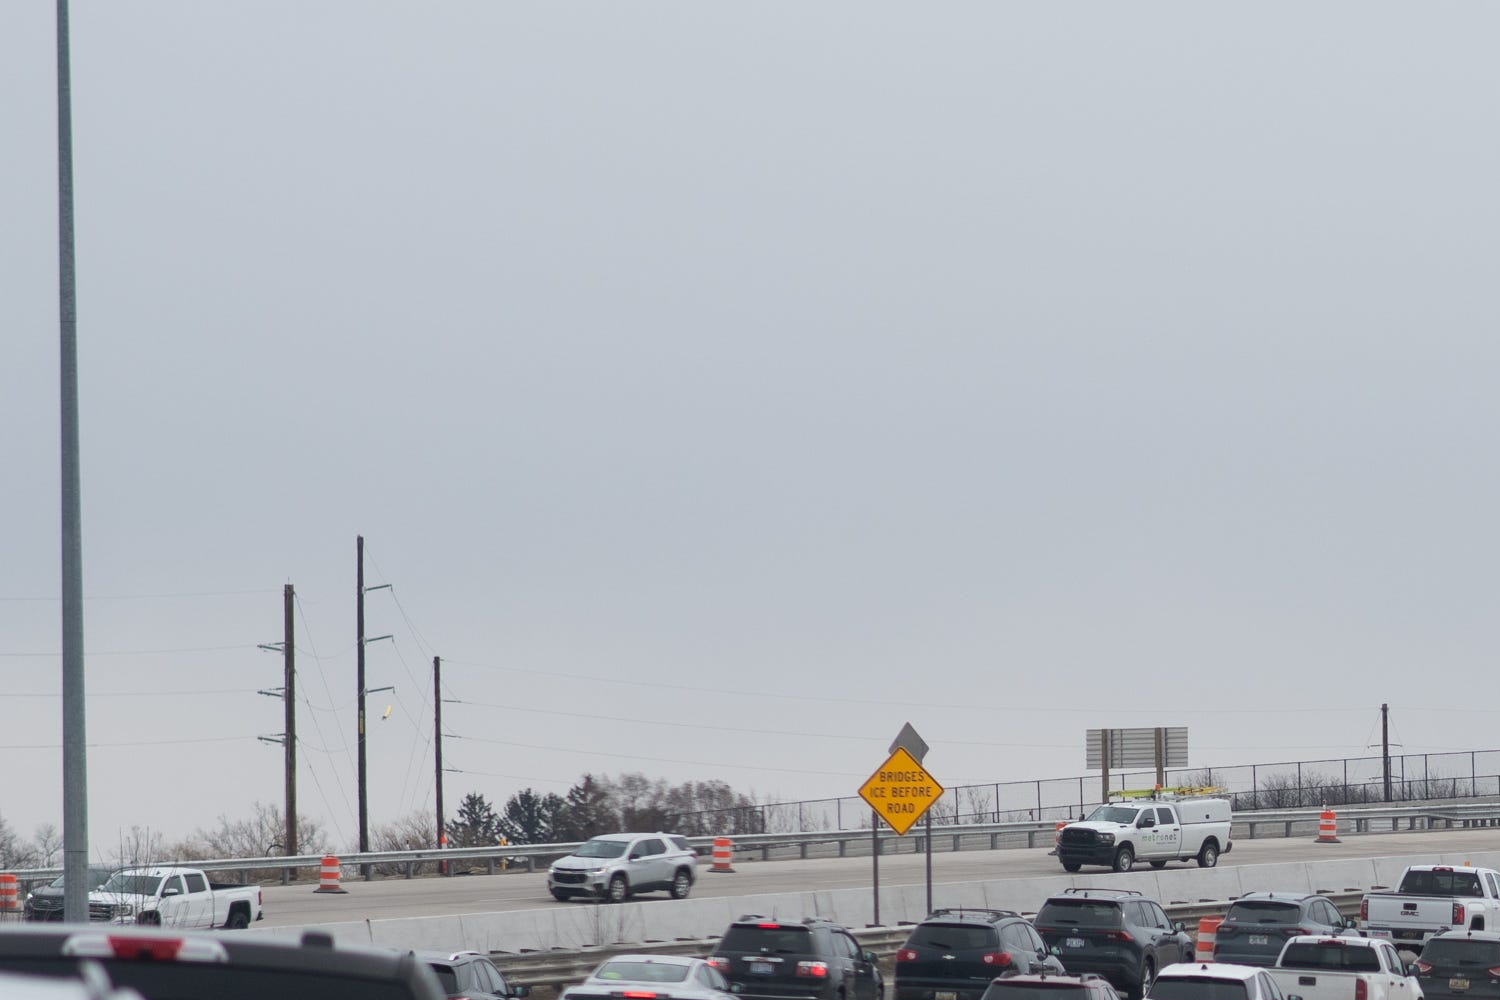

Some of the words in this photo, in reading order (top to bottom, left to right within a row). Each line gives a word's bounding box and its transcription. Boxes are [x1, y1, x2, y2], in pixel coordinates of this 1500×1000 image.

[880, 771, 924, 782] BRIDGES
[870, 787, 886, 798] ICE
[891, 786, 932, 798] BEFORE
[887, 803, 915, 814] ROAD
[1142, 833, 1177, 841] metronet
